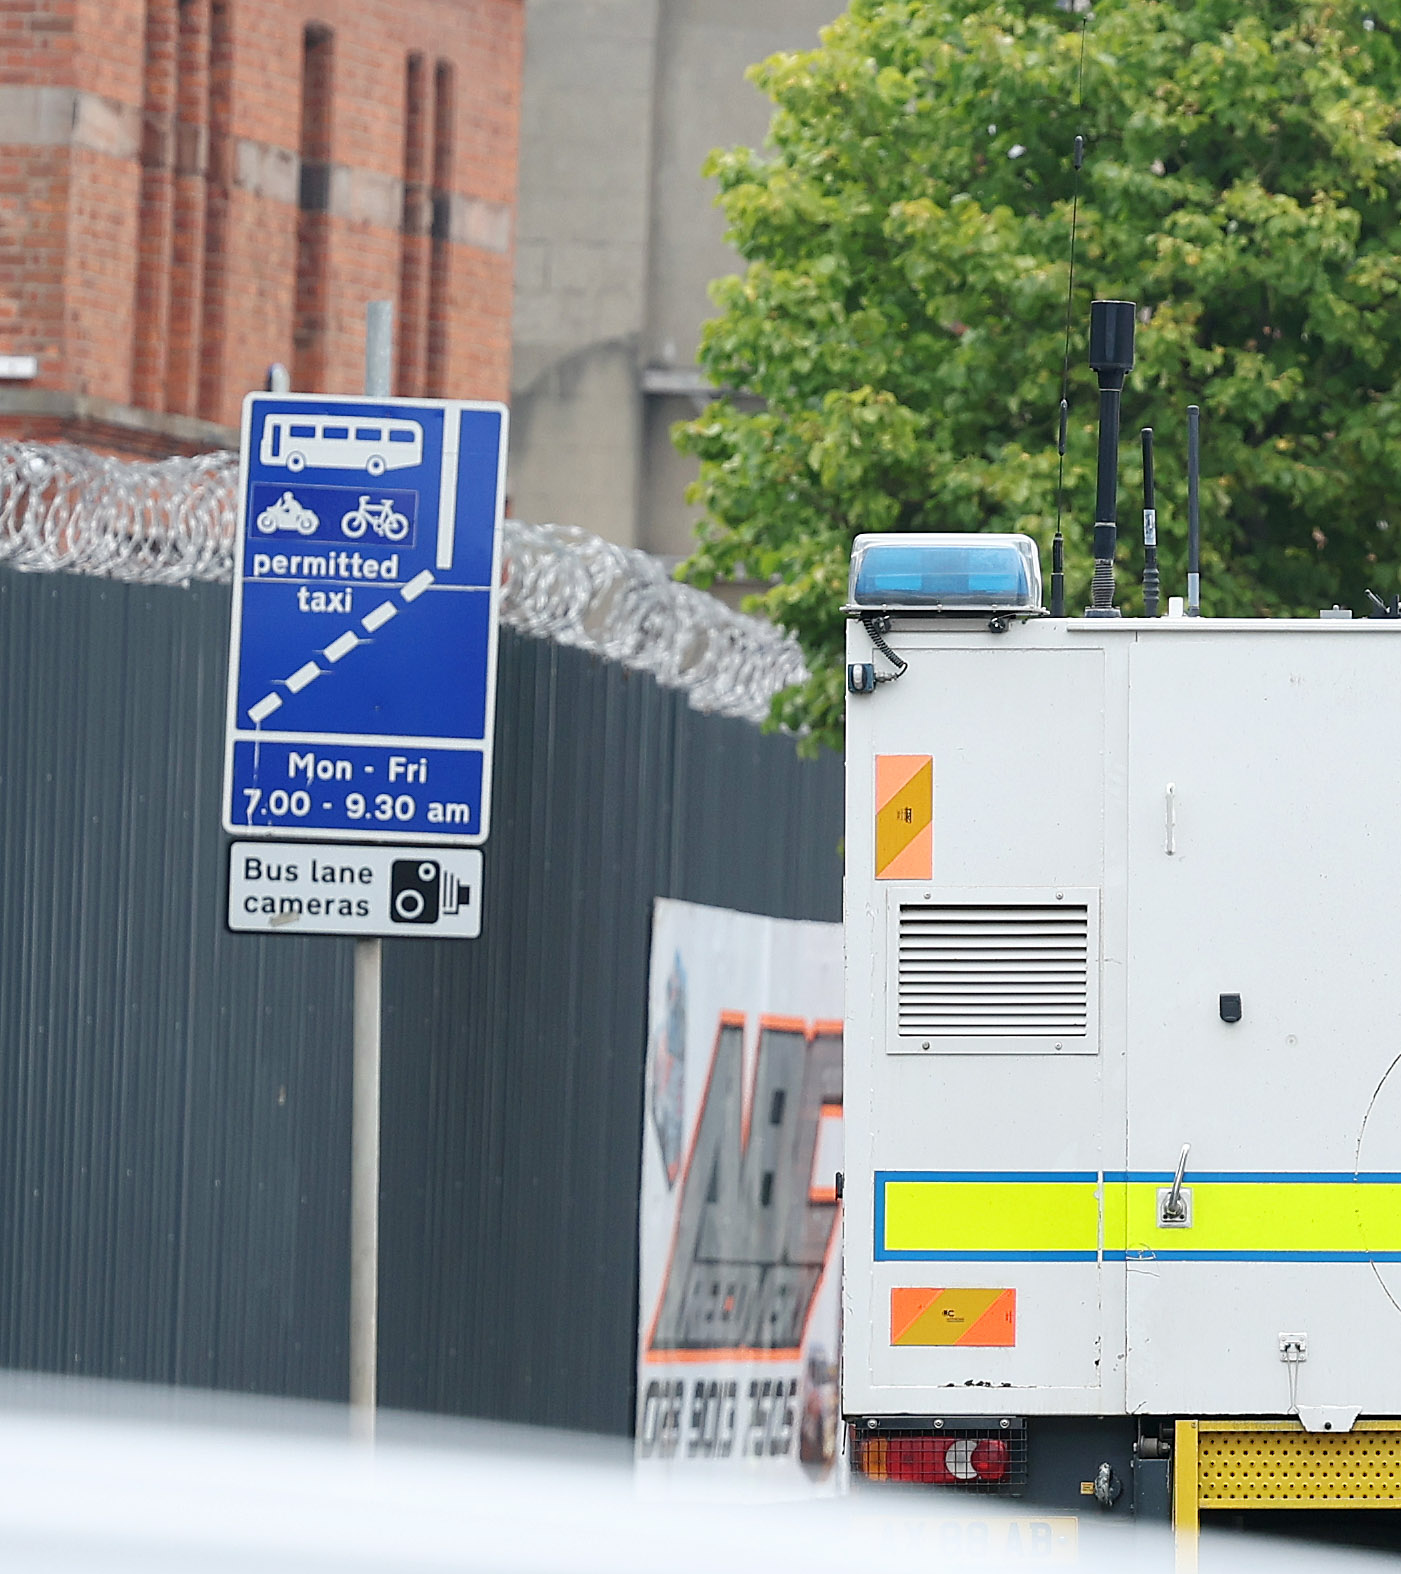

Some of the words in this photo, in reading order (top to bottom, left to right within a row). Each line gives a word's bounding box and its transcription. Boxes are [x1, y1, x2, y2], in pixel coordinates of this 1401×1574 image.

[252, 551, 399, 580] permitted
[298, 586, 353, 614] taxi
[287, 752, 353, 782] Mon
[388, 756, 428, 784] Fri
[243, 788, 311, 817] 7.00
[345, 792, 416, 822] 9.30
[427, 801, 471, 824] am
[243, 857, 300, 883] Bus
[311, 859, 374, 886] lane
[243, 893, 371, 918] cameras
